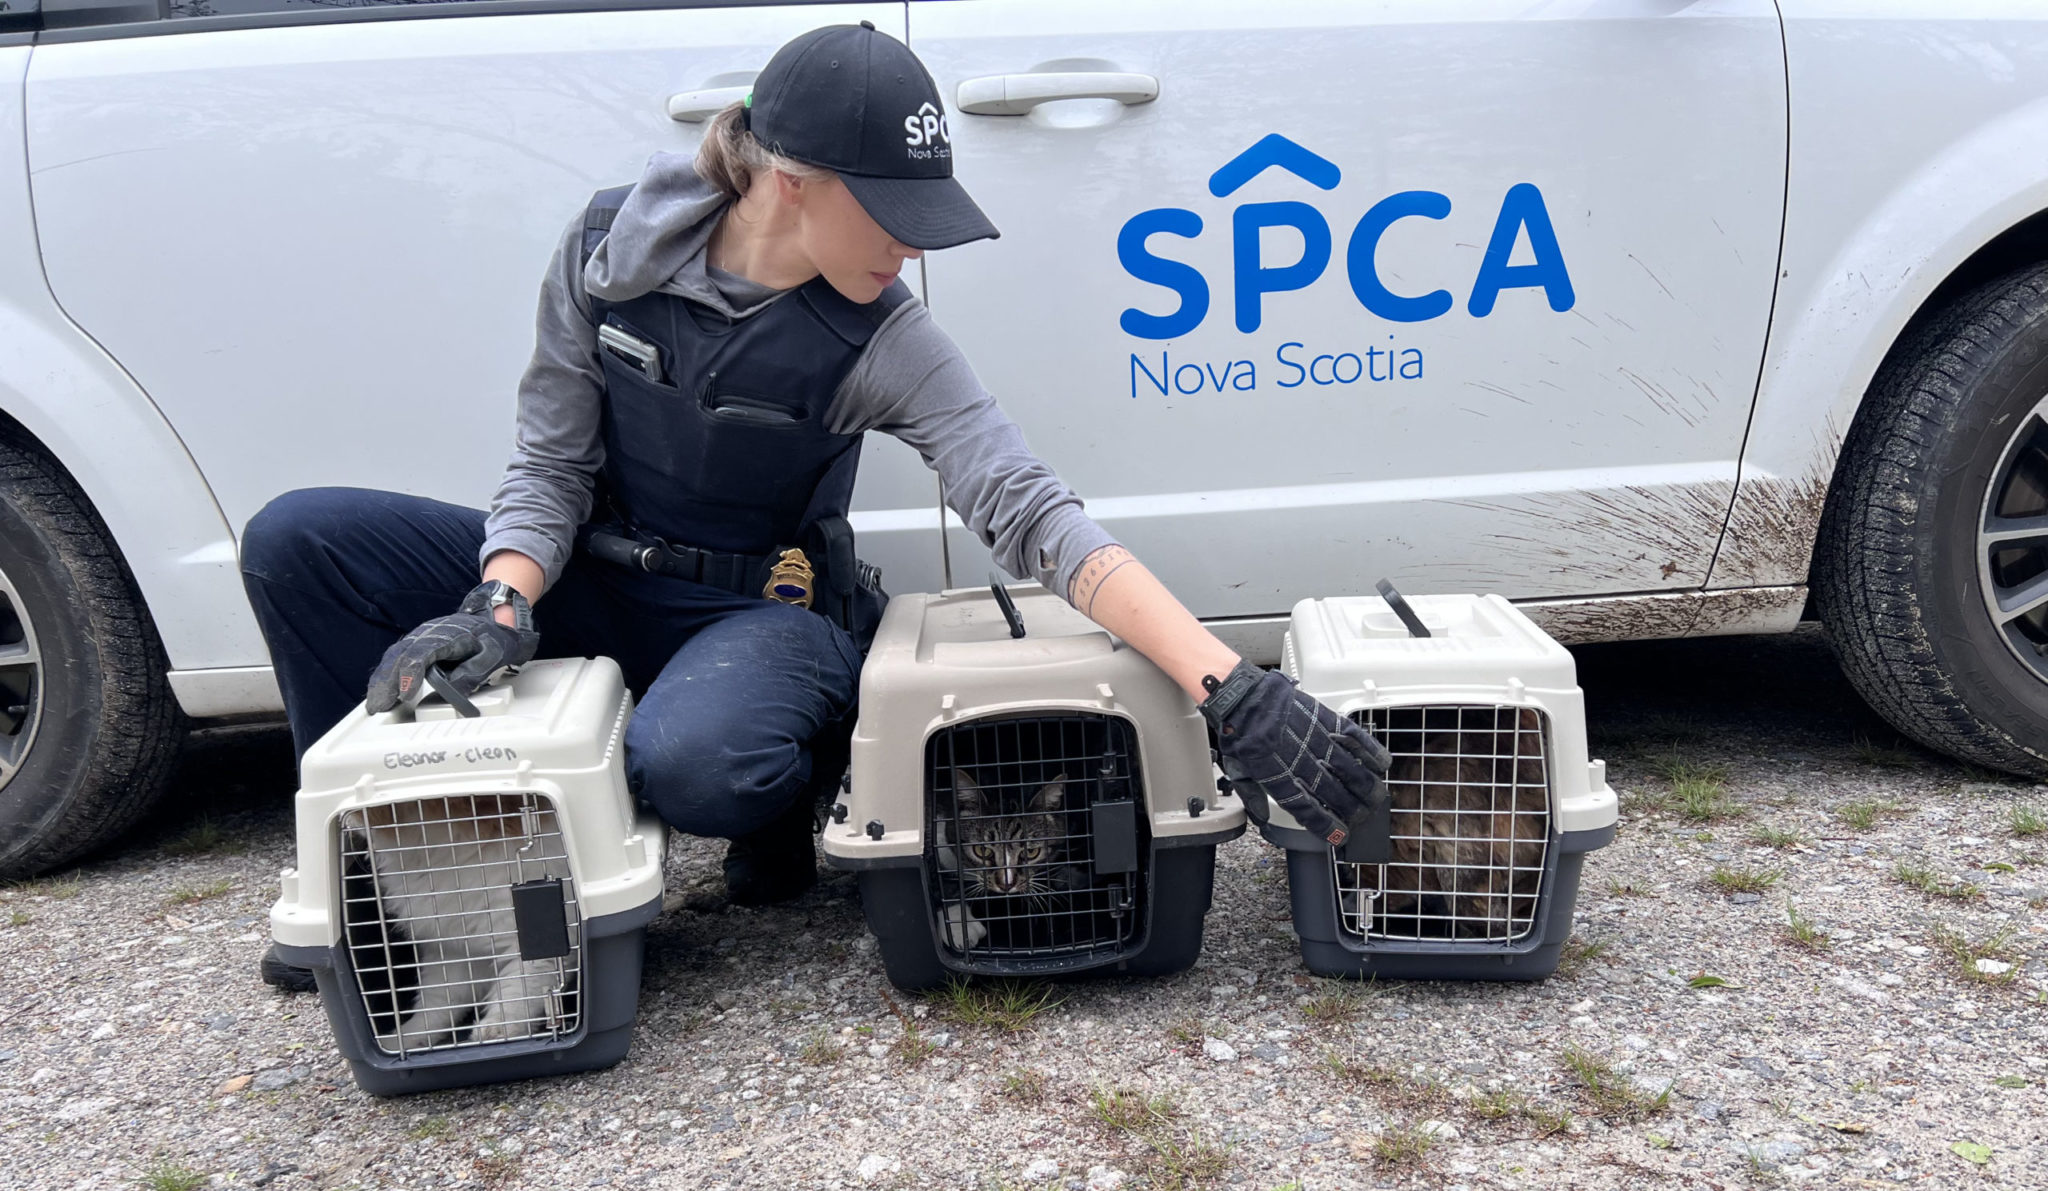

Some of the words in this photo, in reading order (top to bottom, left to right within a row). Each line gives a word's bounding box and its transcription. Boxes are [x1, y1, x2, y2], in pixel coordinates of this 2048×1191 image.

[904, 114, 950, 146] SPC
[907, 147, 932, 160] Nova
[1117, 182, 1577, 341] SPCA
[1130, 351, 1256, 399] Nova
[1276, 335, 1424, 389] Scotia
[384, 750, 447, 770] Eleanor
